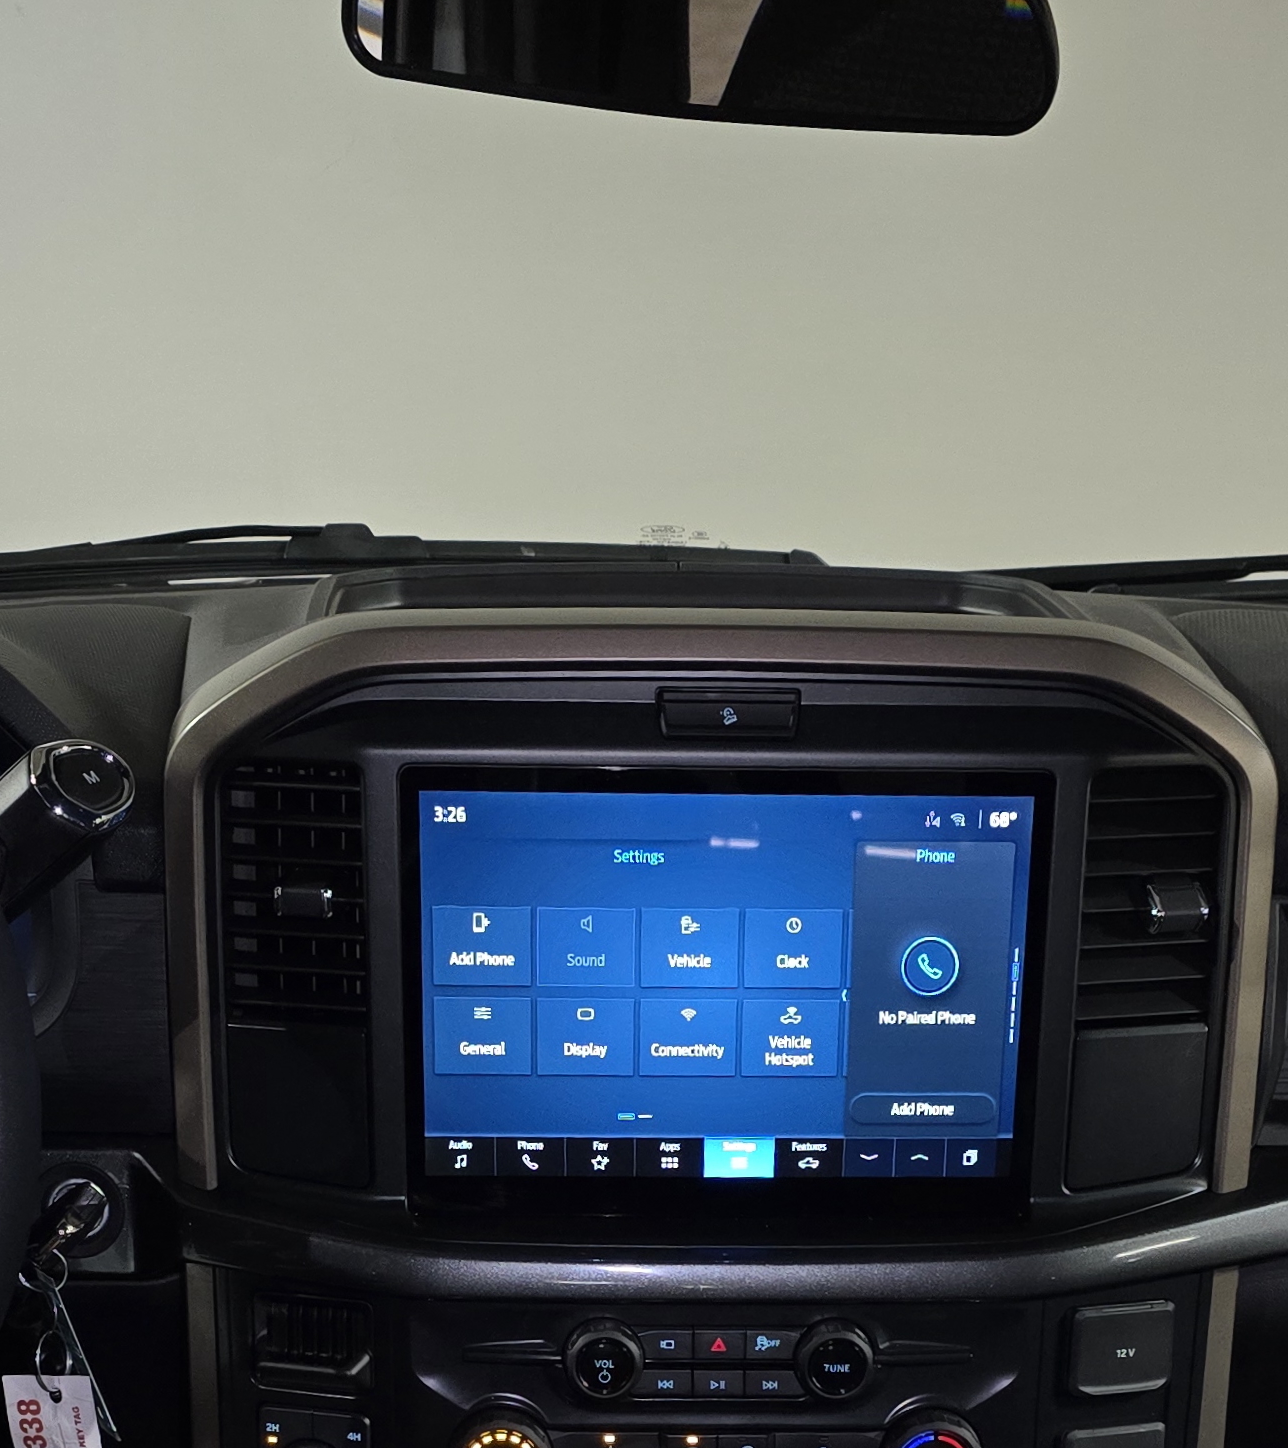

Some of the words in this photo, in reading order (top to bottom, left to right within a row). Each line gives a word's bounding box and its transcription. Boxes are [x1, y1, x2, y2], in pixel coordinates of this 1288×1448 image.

[82, 770, 101, 785] M
[433, 805, 467, 823] 3:26
[613, 849, 665, 866] Settings
[915, 848, 956, 864] Phone
[449, 952, 475, 967] Add
[476, 952, 516, 967] Phone
[566, 953, 606, 968] Sound
[667, 953, 712, 969] Vehicle
[776, 954, 811, 969] Clock
[878, 1011, 897, 1025] No
[897, 1011, 936, 1025] Paired
[936, 1011, 976, 1026] Phone
[459, 1041, 506, 1057] General
[563, 1041, 608, 1059] Display
[768, 1035, 812, 1050] Vehicle
[650, 1042, 725, 1060] Connectivity
[764, 1052, 815, 1068] Hotspot
[890, 1102, 915, 1117] Add
[916, 1102, 955, 1117] Phone
[448, 1139, 473, 1152] Audio
[592, 1140, 609, 1152] Fav
[659, 1141, 681, 1153] Apps
[791, 1141, 828, 1152] Features
[764, 1339, 780, 1348] OFF
[594, 1359, 615, 1369] VOL
[823, 1363, 851, 1373] TUNE
[72, 1405, 82, 1426] TAG
[265, 1423, 280, 1432] 2H
[75, 1428, 87, 1448] KEY
[347, 1432, 362, 1442] 4H
